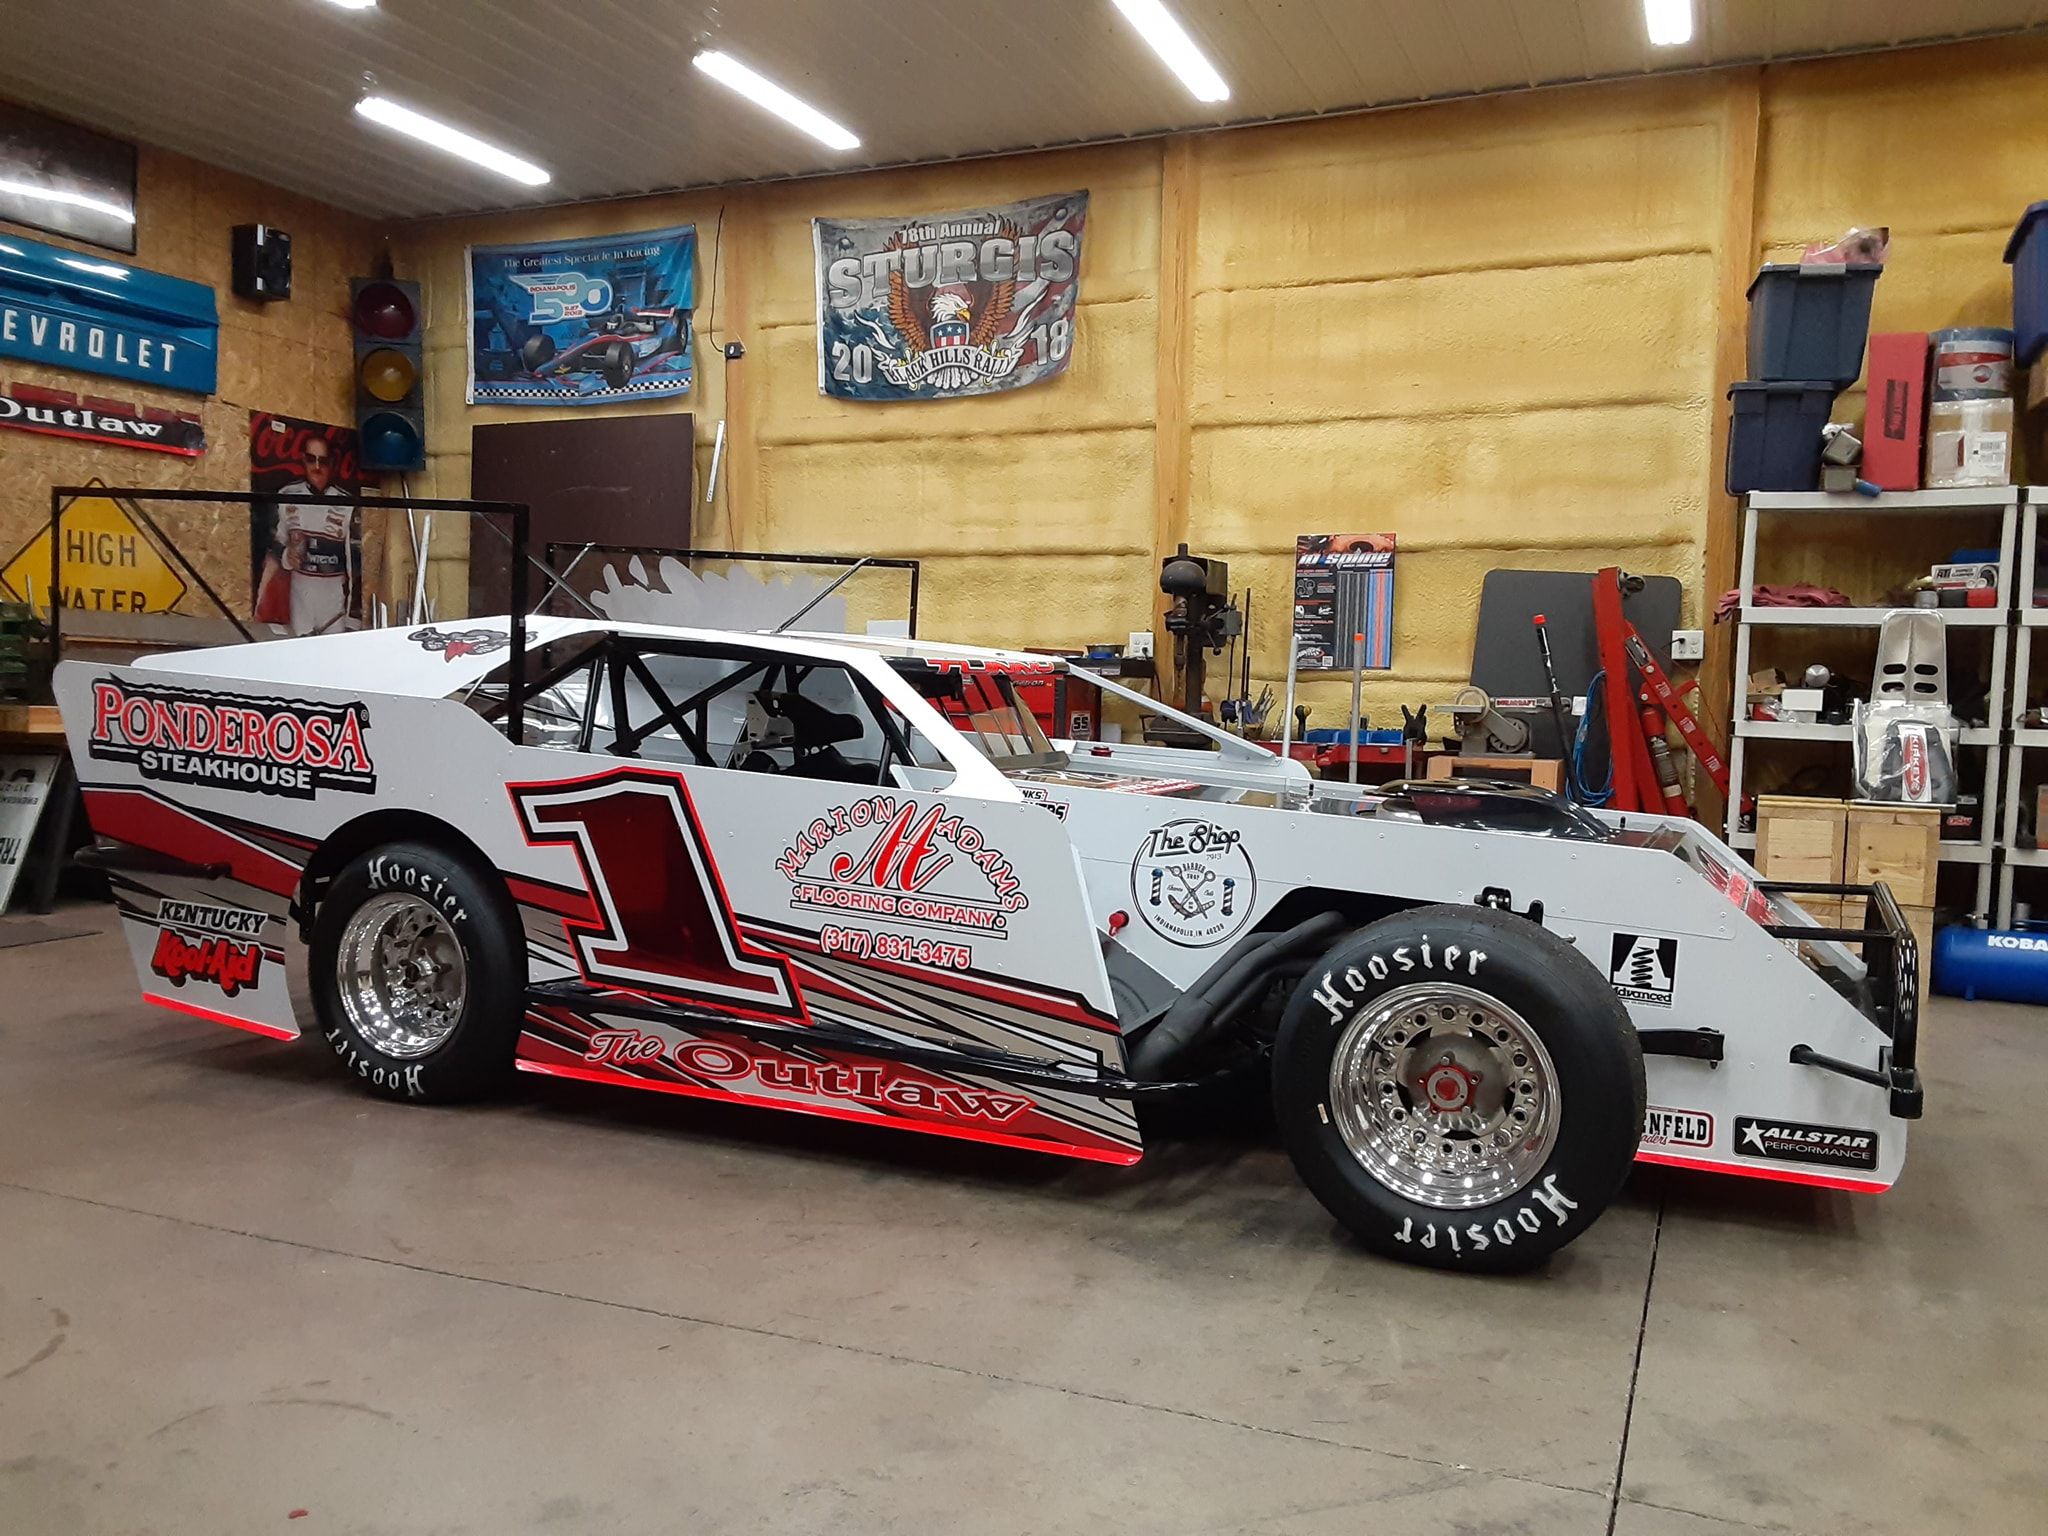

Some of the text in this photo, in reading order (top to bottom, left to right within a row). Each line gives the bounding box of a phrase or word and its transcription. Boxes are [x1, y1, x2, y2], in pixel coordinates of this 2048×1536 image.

[899, 219, 1001, 244] 78th Annual
[504, 245, 660, 267] The Greatest Spectacle In Racing
[829, 230, 1075, 308] STURGIS
[529, 284, 576, 292] INDIANAPOLIS
[887, 348, 1014, 382] BLACK HILLS RALLY
[0, 397, 163, 437] Outlaw
[67, 529, 136, 567] HIGH
[306, 552, 338, 564] wrench
[94, 684, 372, 772] PONDEROSA
[142, 750, 311, 789] STEAKHOUSE
[1912, 735, 1920, 783] KIRKEY
[776, 796, 896, 880] MARION
[1149, 823, 1240, 858] The Shop
[937, 815, 1028, 912] ADAMS
[367, 855, 467, 924] Hoosier
[505, 766, 813, 1026] 1
[801, 885, 996, 927] FLOORING COMPANY
[159, 901, 267, 933] KENTUCKY
[152, 927, 262, 993] Kool-Aid
[821, 925, 971, 969] (317) 831-3475
[1313, 934, 1488, 1025] Hoosier
[326, 1028, 425, 1096] Hoosier
[588, 1031, 1034, 1122] The Outlaw
[1641, 1132, 1668, 1145] aders
[1643, 1112, 1707, 1141] NFELD
[1763, 1126, 1871, 1149] ALLSTAR
[1764, 1140, 1870, 1160] PERFORMANCE
[1394, 1173, 1578, 1258] Hoosier
